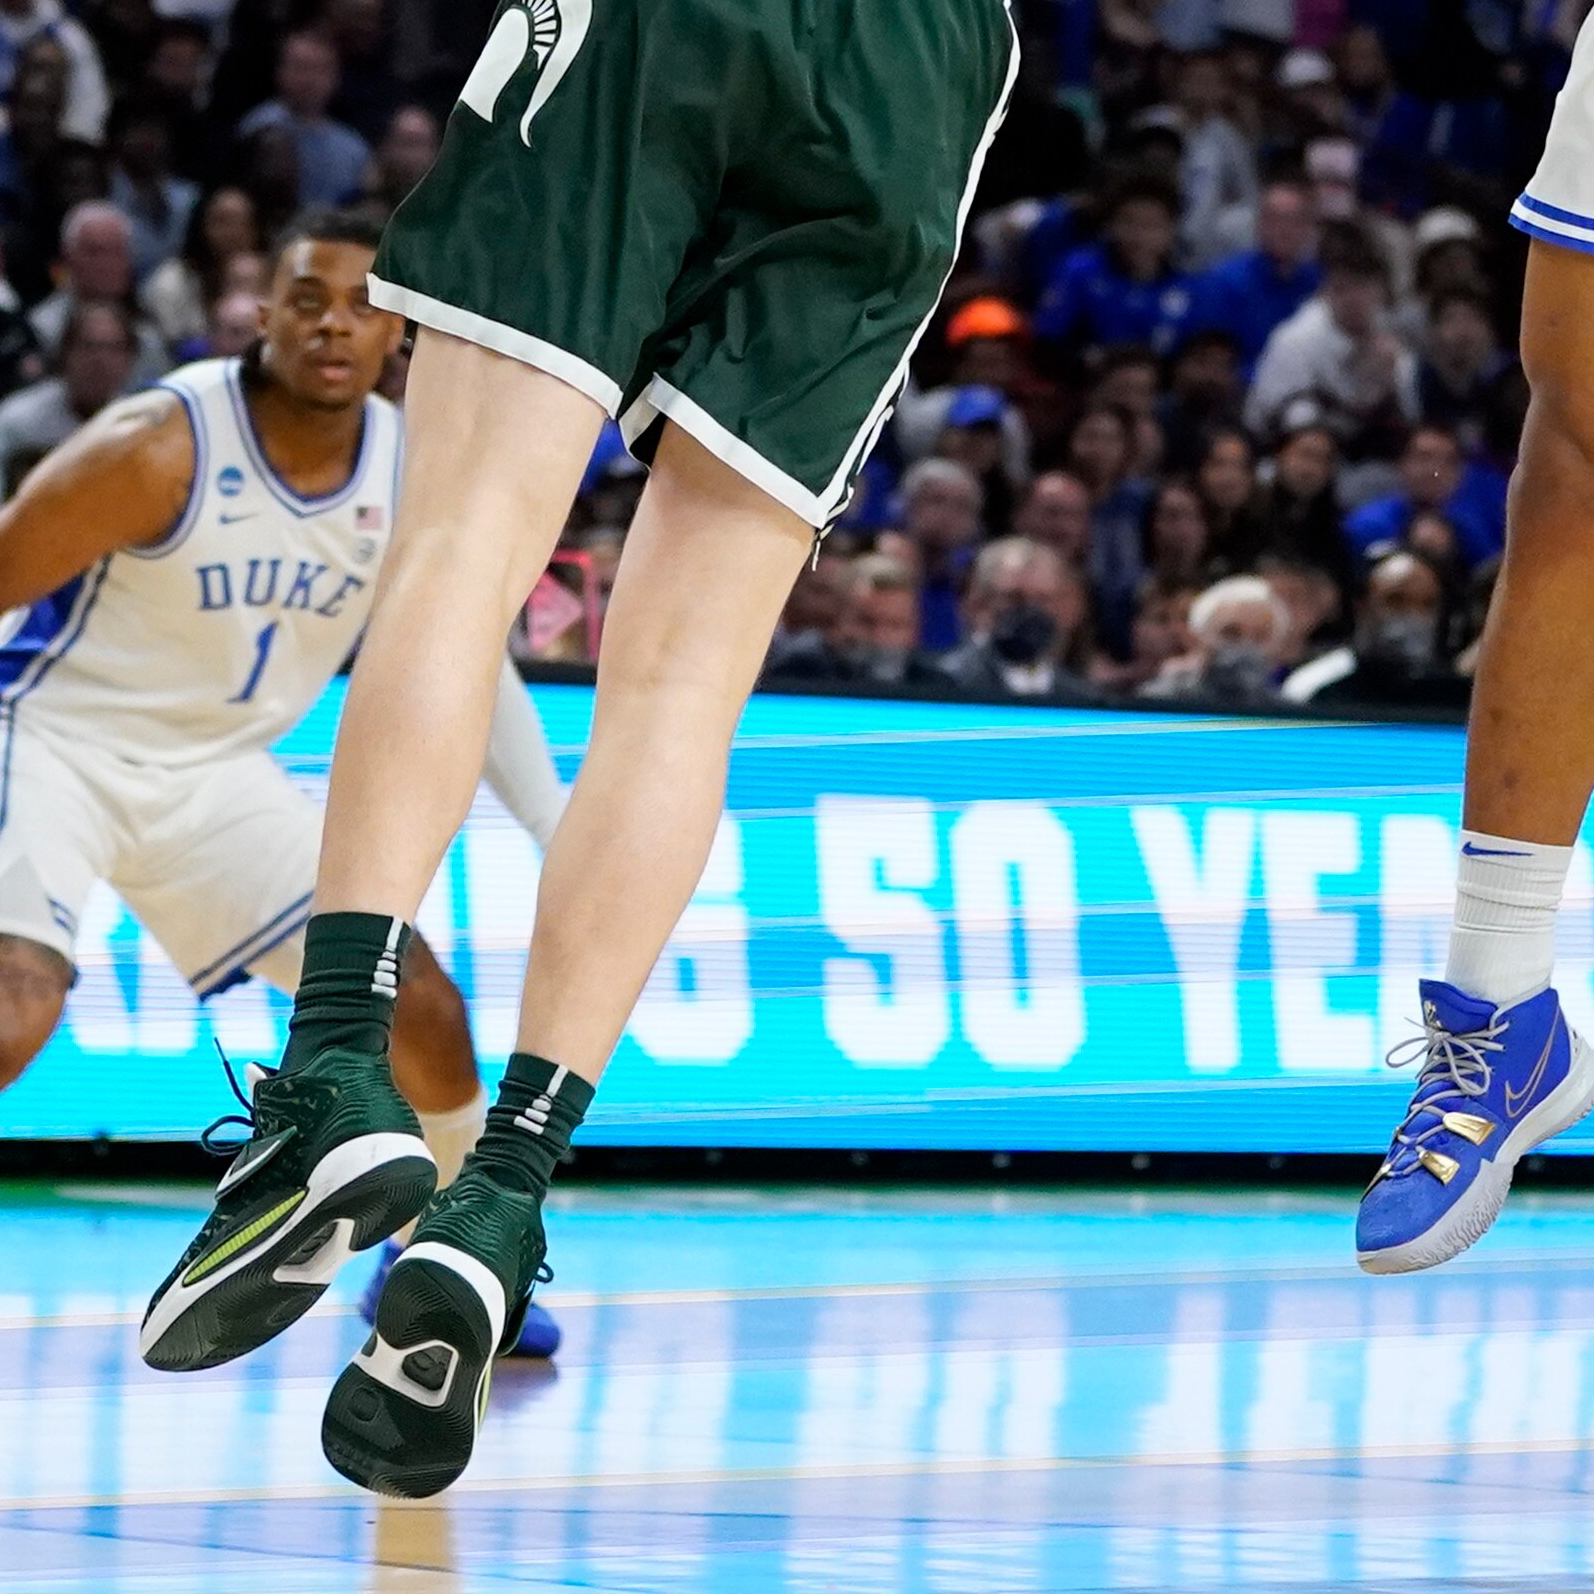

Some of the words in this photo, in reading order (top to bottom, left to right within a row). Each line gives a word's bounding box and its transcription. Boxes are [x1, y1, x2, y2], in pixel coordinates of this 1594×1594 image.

[196, 558, 364, 618] DUKE
[229, 621, 279, 704] 1
[814, 794, 1088, 1073] 50
